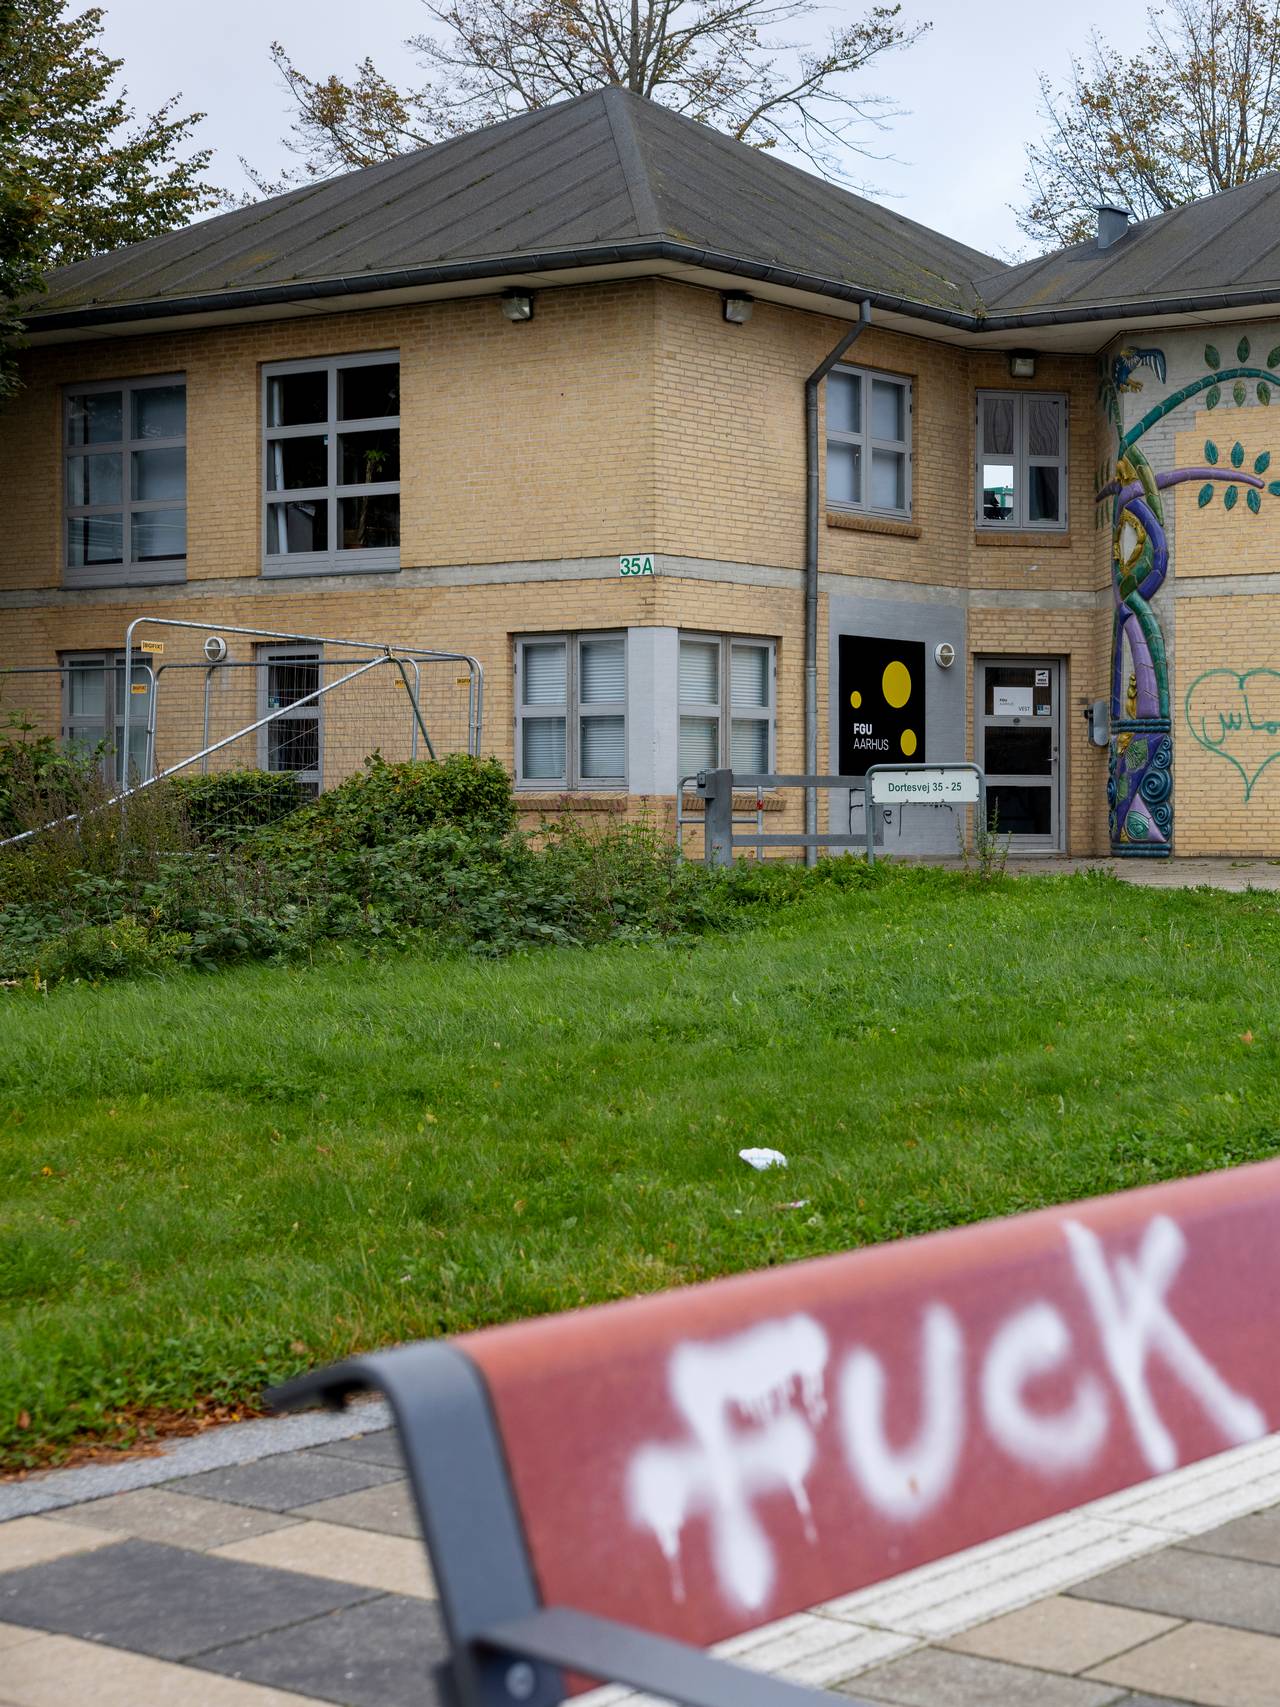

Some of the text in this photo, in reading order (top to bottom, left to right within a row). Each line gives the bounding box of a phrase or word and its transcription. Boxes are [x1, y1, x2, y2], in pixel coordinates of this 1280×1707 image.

[620, 557, 653, 575] 35A
[853, 723, 873, 735] FGU
[853, 738, 889, 751] AARHUS
[888, 782, 930, 794] Dortesvej
[932, 782, 943, 792] 35
[951, 782, 962, 792] 25
